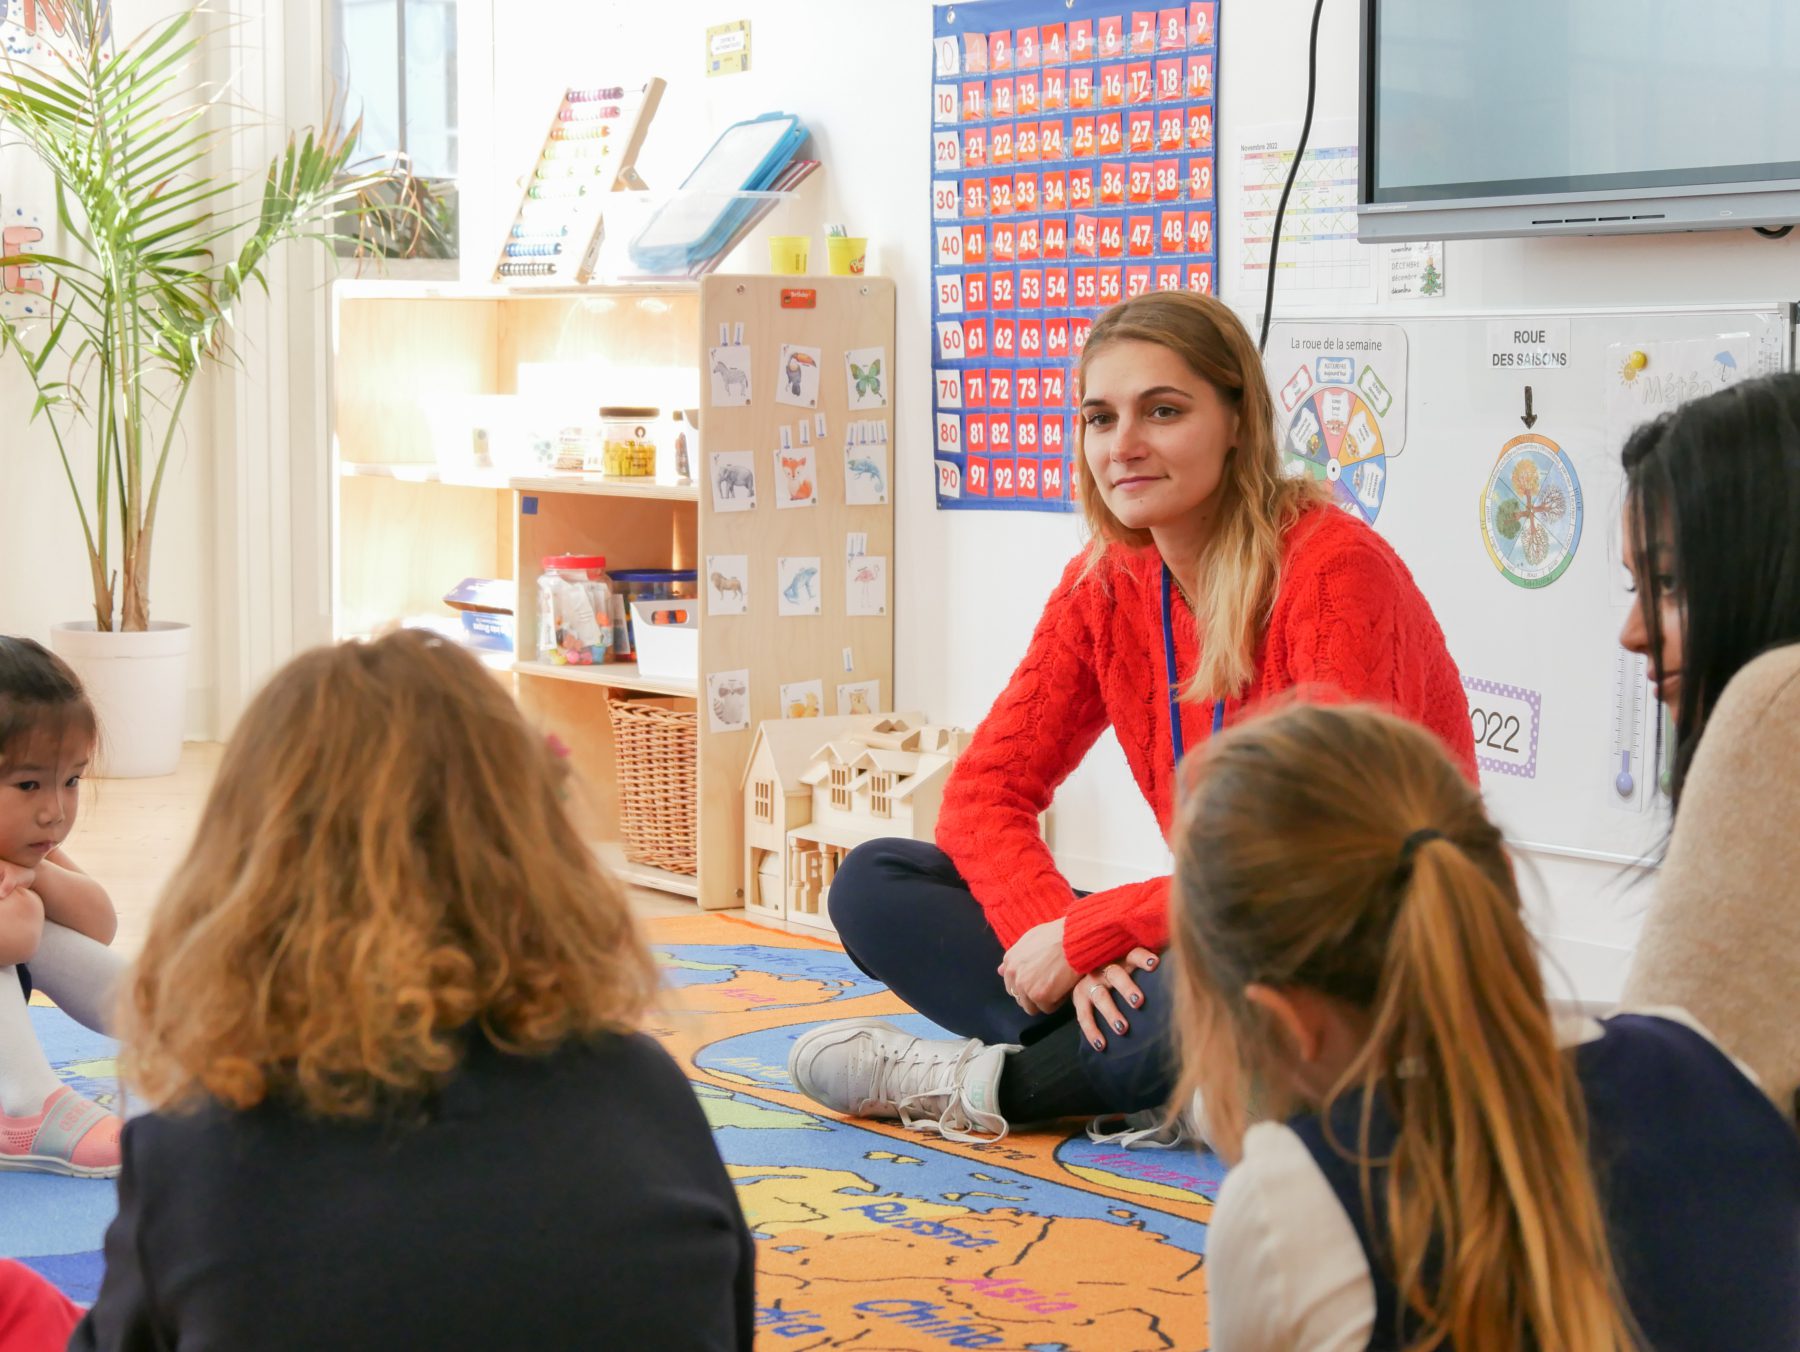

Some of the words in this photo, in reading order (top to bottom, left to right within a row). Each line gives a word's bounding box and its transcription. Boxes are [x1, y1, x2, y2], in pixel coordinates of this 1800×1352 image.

[996, 41, 1005, 61] 2
[1024, 37, 1033, 58] 3
[1050, 34, 1060, 53] 4
[1077, 30, 1086, 51] 5
[1106, 26, 1115, 47] 6
[1139, 22, 1149, 42] 7
[1168, 18, 1178, 40] 8
[1197, 12, 1206, 33] 9
[939, 94, 952, 113] 10
[968, 91, 980, 109] 11
[996, 88, 1010, 108] 12
[1021, 84, 1035, 105] 13
[1047, 78, 1061, 98] 14
[1074, 78, 1088, 98] 15
[1106, 75, 1121, 95] 16
[1132, 71, 1147, 93] 17
[1161, 69, 1177, 90] 18
[1191, 65, 1207, 87] 19
[938, 141, 956, 159] 20
[969, 137, 983, 157] 21
[994, 134, 1011, 155] 22
[1020, 132, 1036, 152] 23
[1043, 129, 1060, 150] 24
[1075, 126, 1093, 147] 25
[1100, 123, 1119, 144] 26
[1132, 121, 1150, 142] 27
[1162, 119, 1181, 140] 28
[1191, 116, 1209, 138] 29
[1266, 142, 1278, 150] 2022
[936, 190, 955, 209] 30
[968, 187, 982, 208] 31
[993, 185, 1010, 205] 32
[1018, 182, 1035, 202] 33
[1046, 180, 1063, 201] 34
[1073, 178, 1091, 199] 35
[1103, 173, 1122, 194] 36
[1132, 172, 1150, 193] 37
[1157, 169, 1176, 190] 38
[1192, 168, 1210, 189] 39
[942, 236, 959, 255] 40
[968, 234, 982, 254] 41
[995, 232, 1012, 252] 42
[1021, 229, 1037, 250] 43
[1046, 229, 1064, 249] 44
[1077, 225, 1094, 247] 45
[1102, 227, 1120, 248] 46
[1132, 224, 1151, 246] 47
[1164, 221, 1183, 242] 48
[1190, 220, 1208, 242] 49
[942, 285, 959, 302] 50
[969, 281, 983, 302] 51
[994, 279, 1011, 301] 52
[1022, 278, 1039, 300] 53
[1048, 276, 1066, 298] 54
[1077, 275, 1094, 297] 55
[1101, 274, 1119, 297] 56
[1128, 274, 1148, 296] 57
[1159, 273, 1178, 290] 58
[1190, 271, 1209, 292] 59
[943, 331, 960, 349] 60
[968, 328, 982, 349] 61
[995, 326, 1012, 349] 62
[1021, 328, 1039, 349] 63
[1049, 327, 1066, 348] 64
[1291, 337, 1300, 349] La
[1302, 340, 1322, 350] roue
[1323, 337, 1335, 350] de
[1336, 337, 1344, 350] la
[1345, 339, 1383, 351] semaine
[1514, 330, 1545, 343] ROUE
[1492, 353, 1514, 366] DES
[1517, 352, 1567, 366] SAISONS
[940, 380, 958, 398] 70
[968, 378, 982, 398] 71
[991, 378, 1008, 399] 72
[1019, 378, 1036, 398] 73
[1044, 377, 1061, 398] 74
[1642, 371, 1713, 404] Météo
[940, 425, 957, 443] 80
[970, 423, 983, 444] 81
[992, 423, 1008, 443] 82
[1019, 423, 1036, 444] 83
[1044, 423, 1061, 444] 84
[942, 469, 957, 487] 90
[971, 466, 985, 487] 91
[996, 468, 1012, 488] 92
[1019, 469, 1035, 489] 93
[1044, 467, 1060, 488] 94
[1471, 707, 1520, 753] 022
[841, 1202, 999, 1248] Russia
[945, 1278, 1078, 1314] Asia
[852, 1299, 1004, 1348] China
